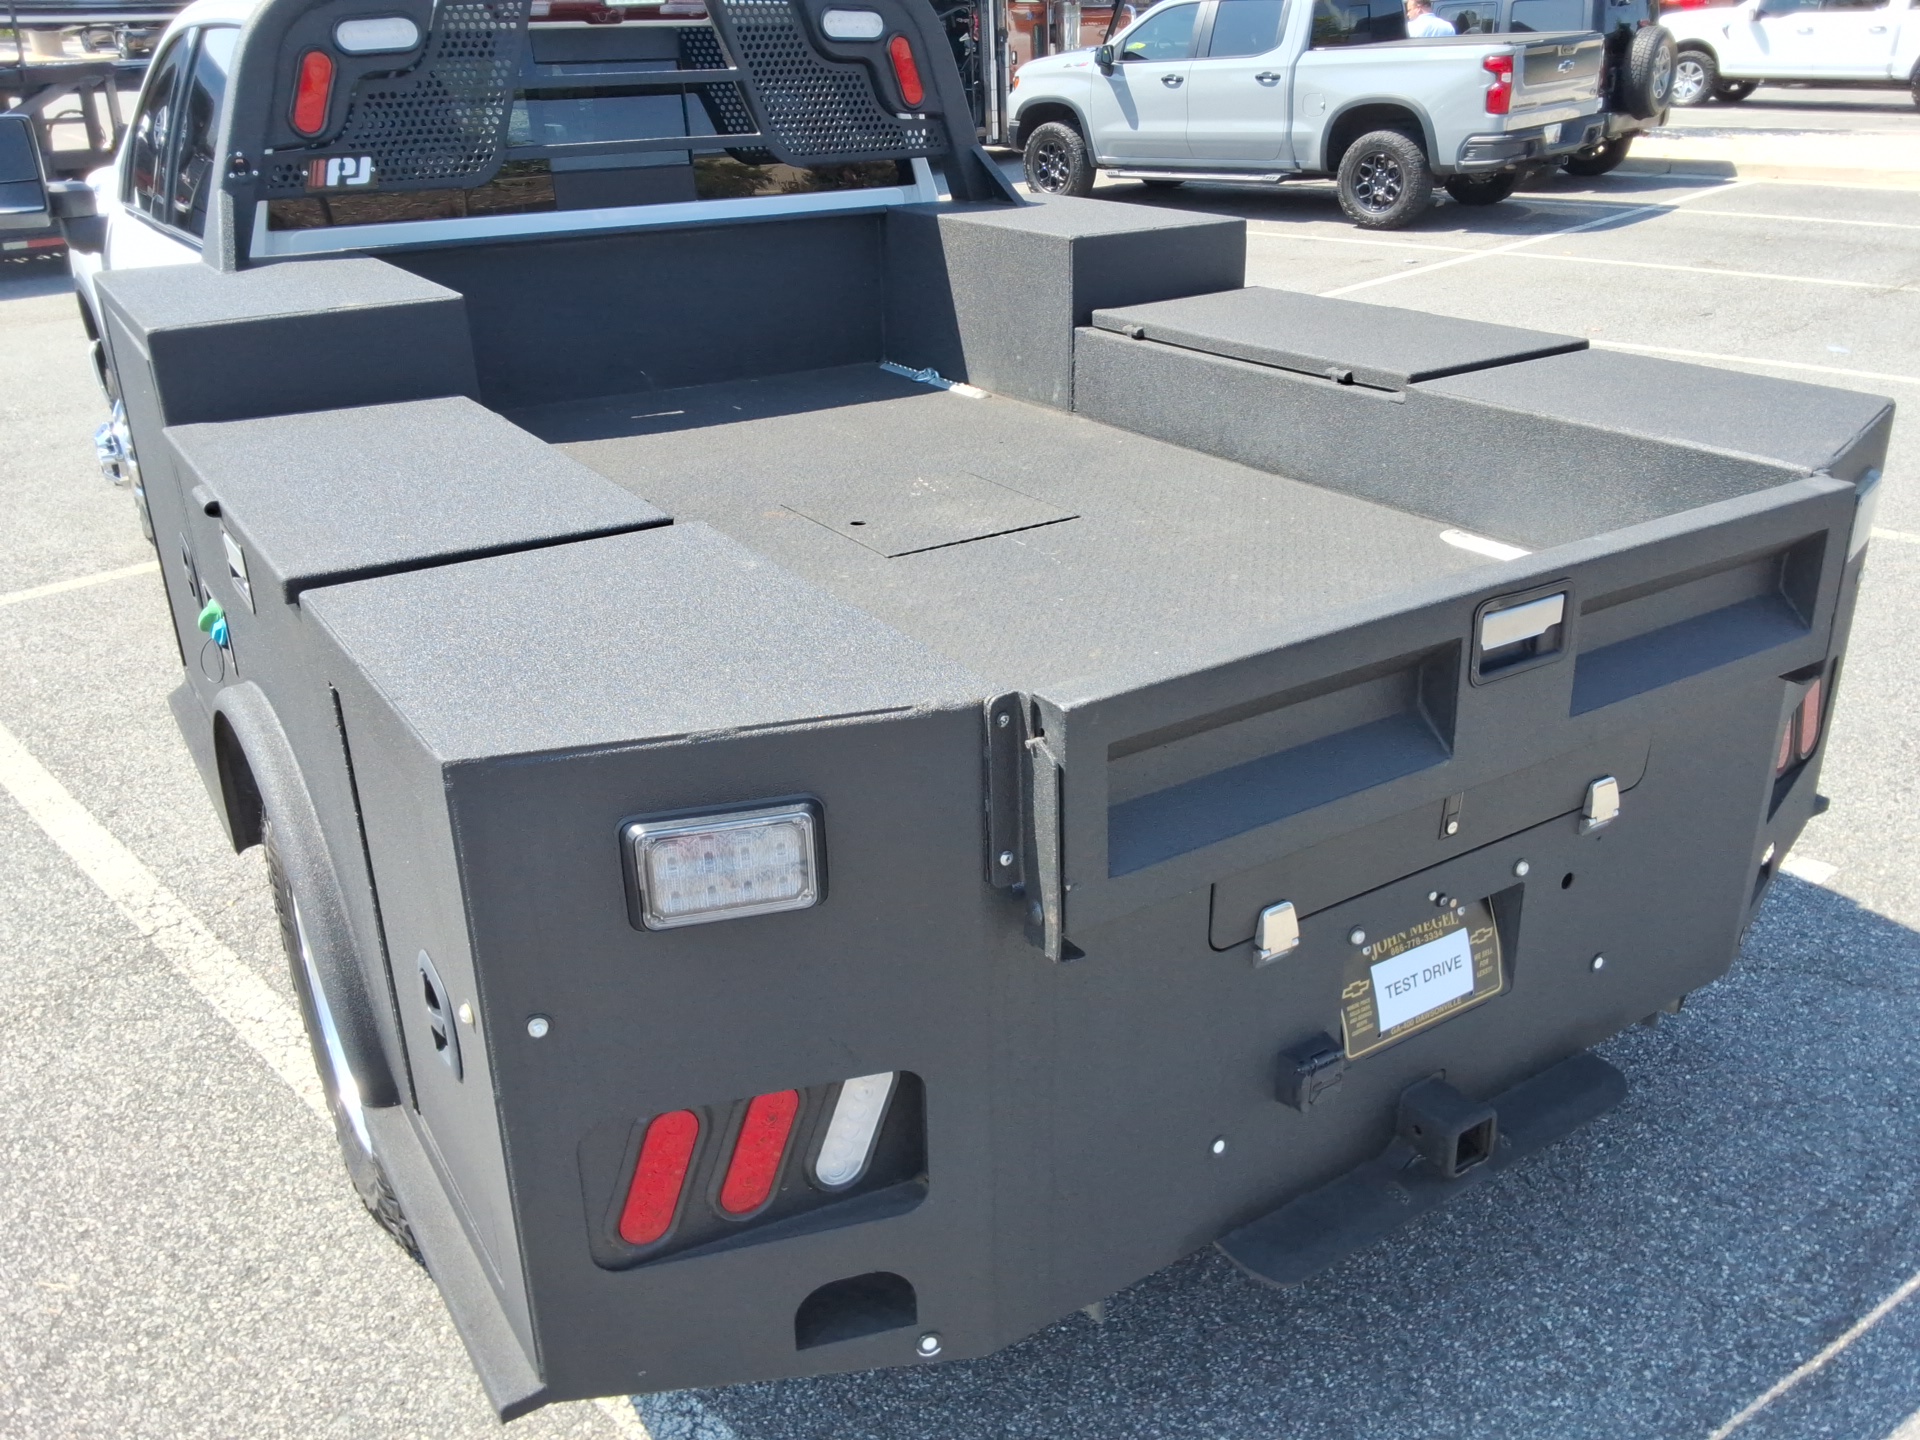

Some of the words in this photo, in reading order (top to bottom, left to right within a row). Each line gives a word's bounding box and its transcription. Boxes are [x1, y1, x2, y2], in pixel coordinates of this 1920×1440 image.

[326, 156, 372, 187] PJ
[1371, 931, 1407, 961] JOHN
[1410, 911, 1459, 937] MEGEL
[1384, 973, 1419, 999] TEST
[1423, 954, 1463, 984] DRIVE
[1415, 997, 1463, 1024] DAWSONVILLE
